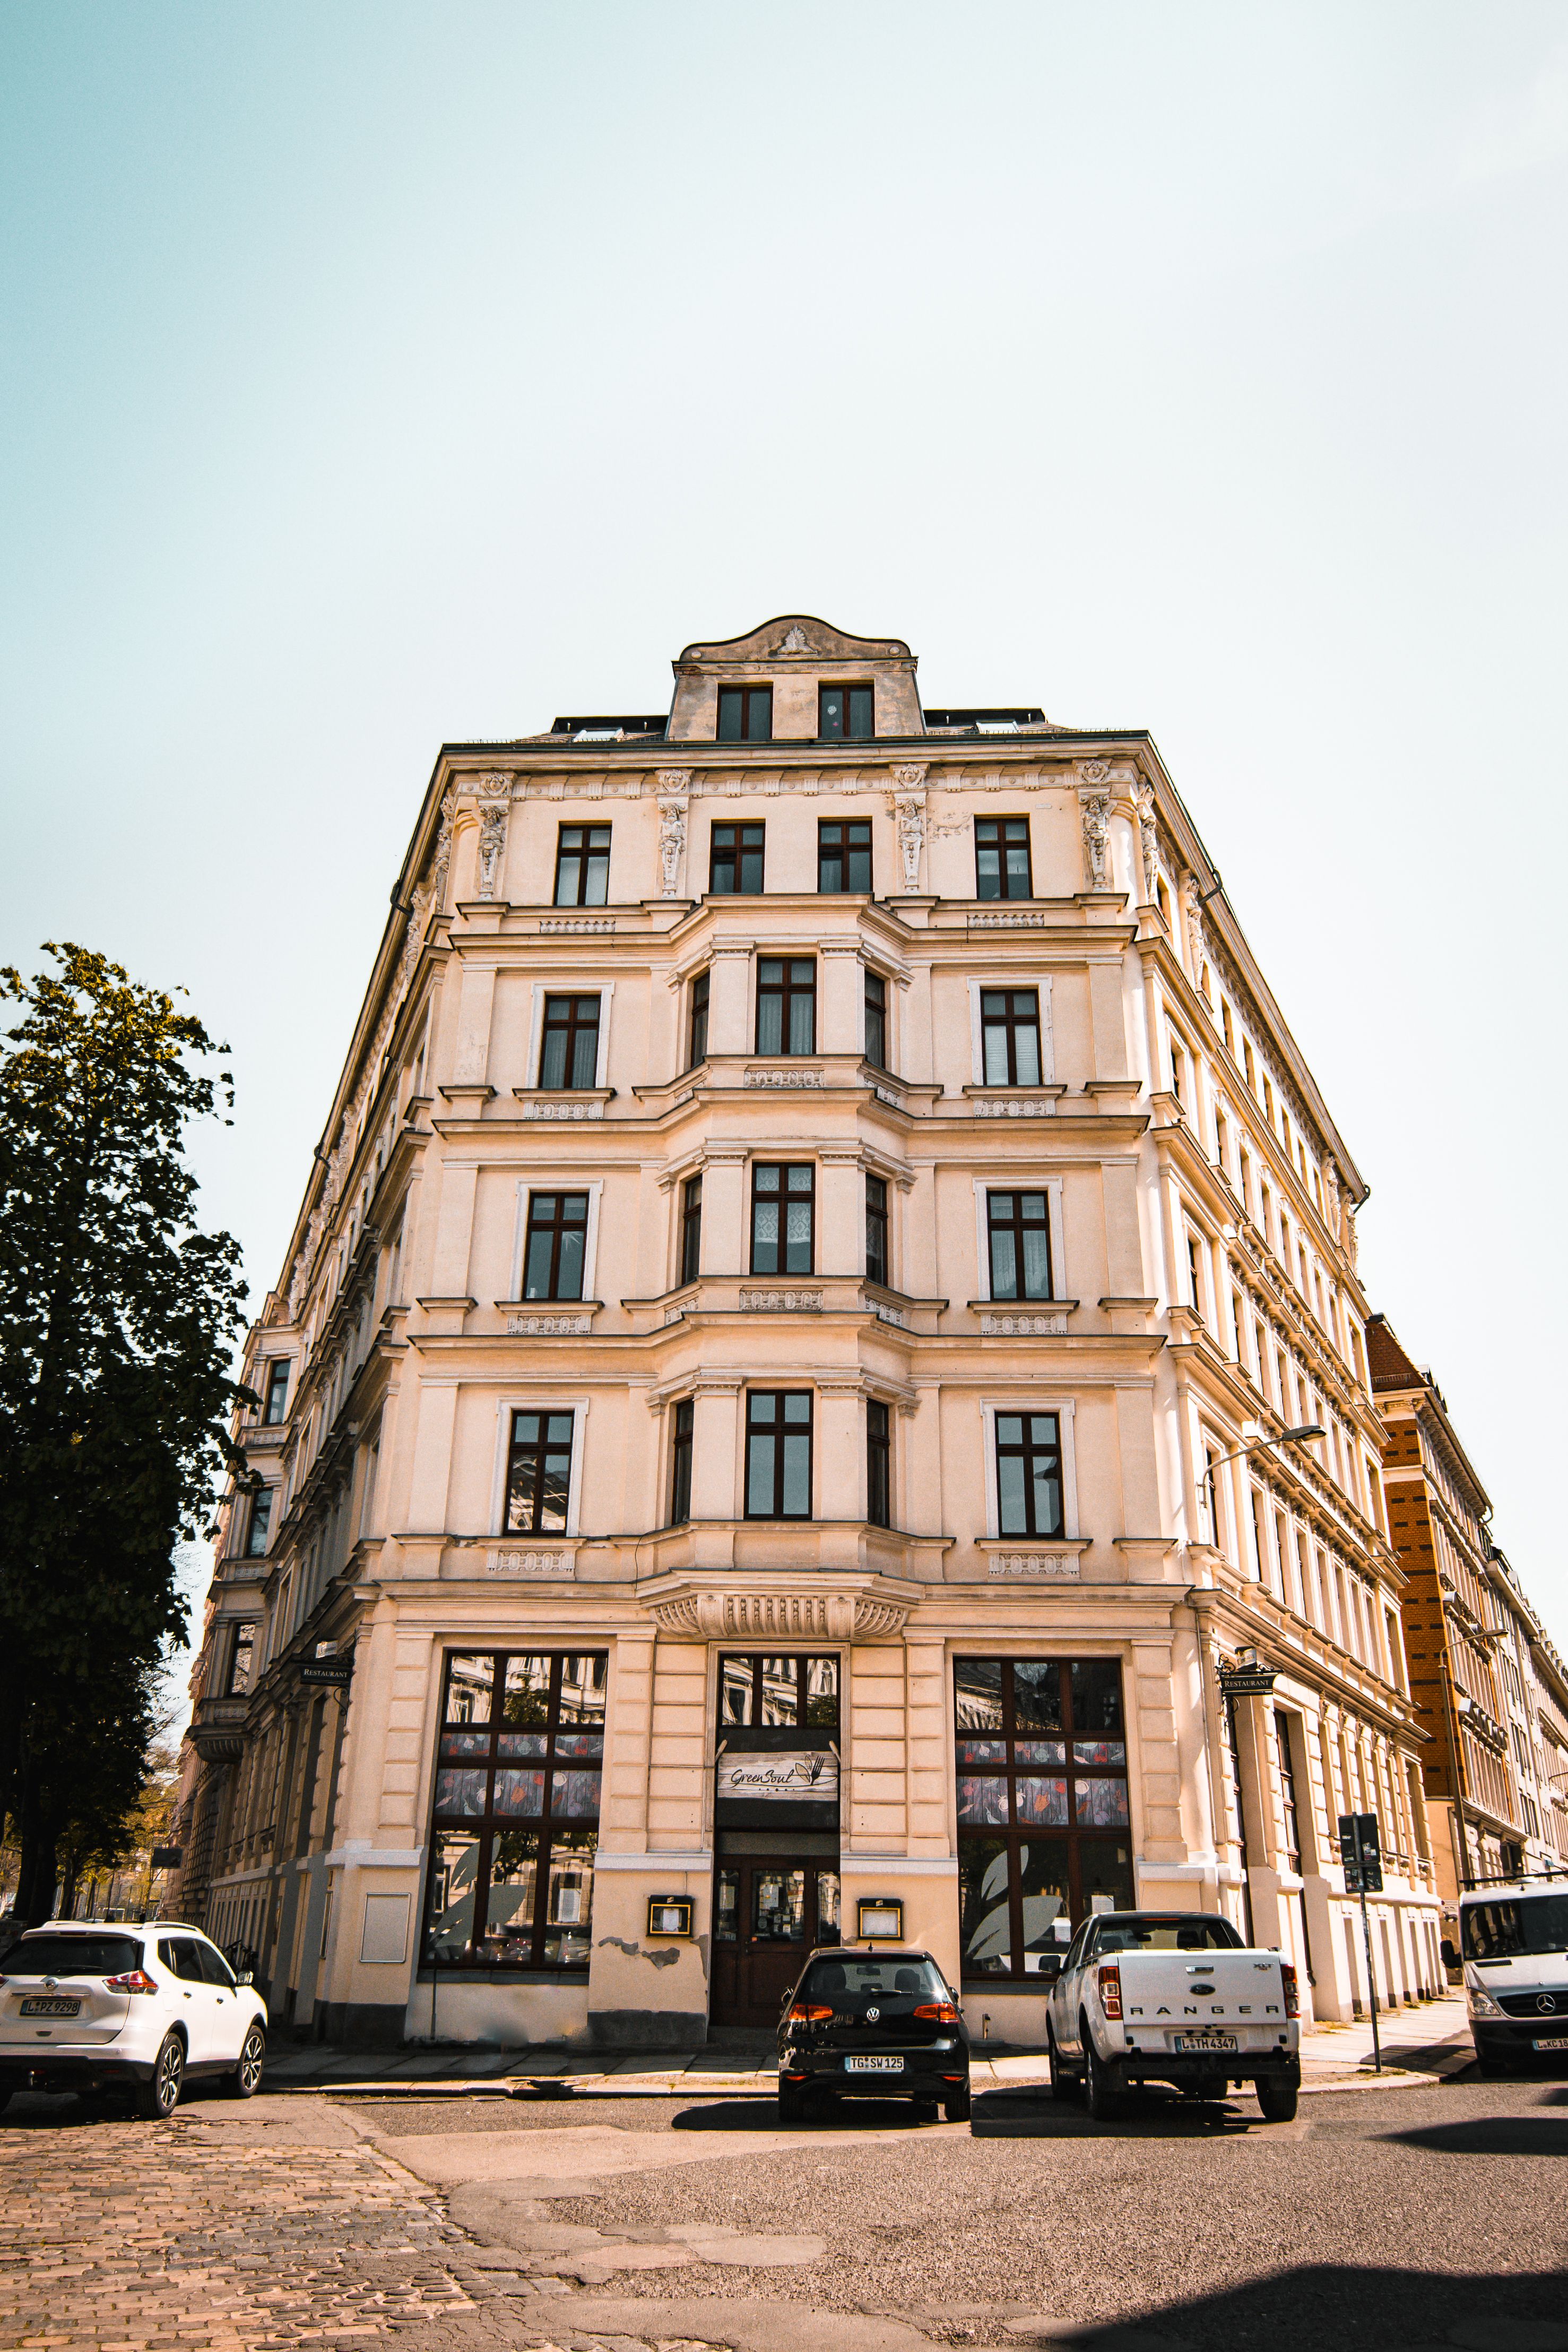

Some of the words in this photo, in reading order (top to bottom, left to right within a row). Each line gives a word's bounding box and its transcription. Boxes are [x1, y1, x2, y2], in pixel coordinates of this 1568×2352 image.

[304, 1668, 349, 1677] RESTAURANT
[55, 2002, 79, 2012] 9298
[1130, 2005, 1279, 2015] RANGER
[1210, 2038, 1234, 2048] 4347
[885, 2057, 903, 2068] 125
